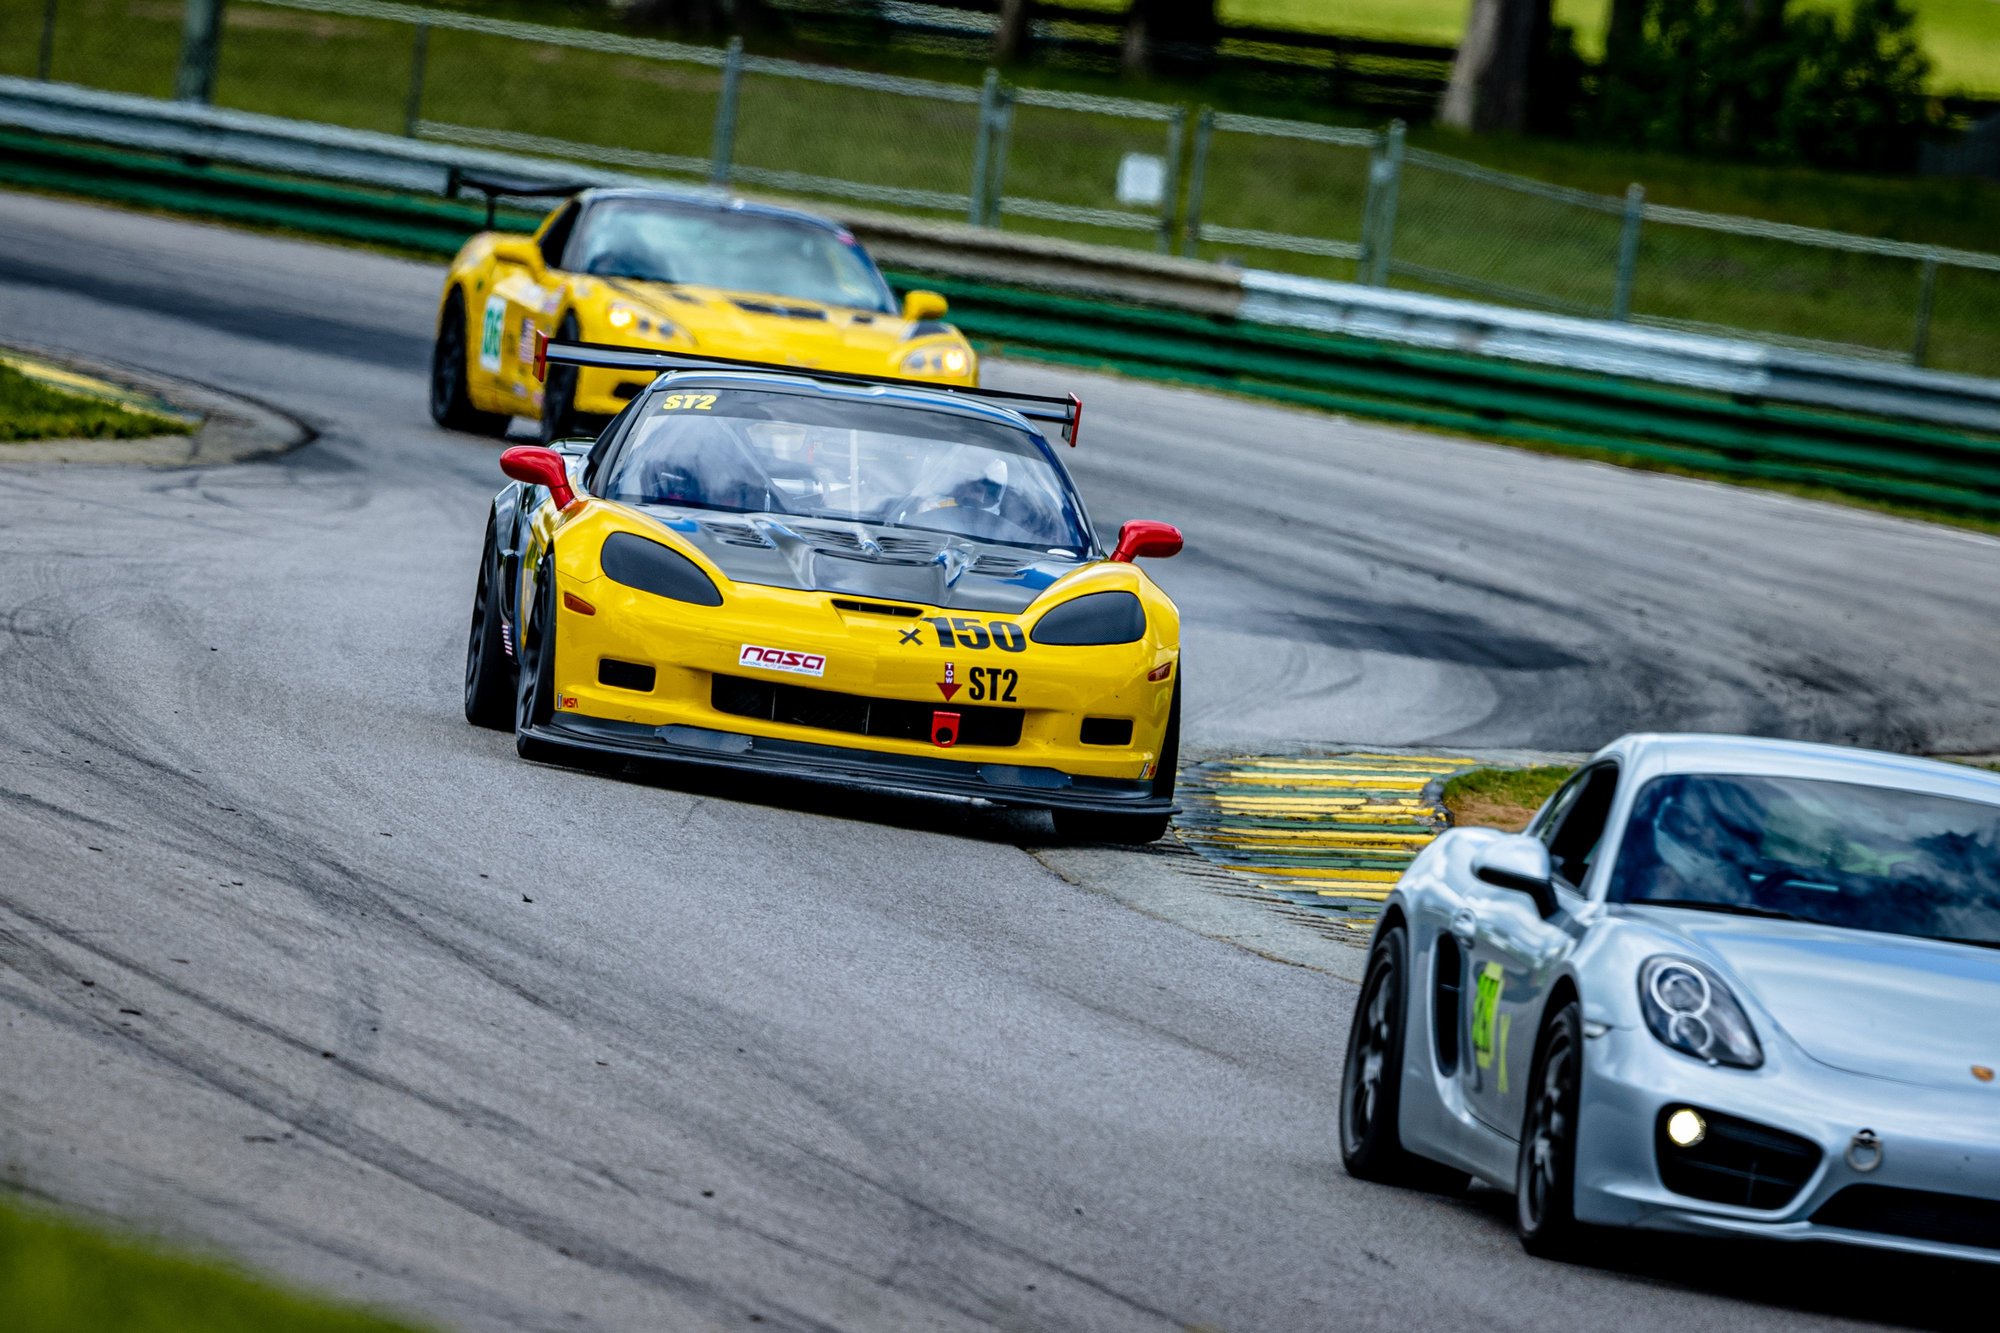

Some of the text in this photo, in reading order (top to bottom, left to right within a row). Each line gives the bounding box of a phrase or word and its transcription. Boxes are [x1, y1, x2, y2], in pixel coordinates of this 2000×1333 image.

[662, 394, 717, 410] ST2
[920, 616, 1027, 653] 150
[945, 662, 954, 684] TOW
[968, 666, 1018, 702] ST2
